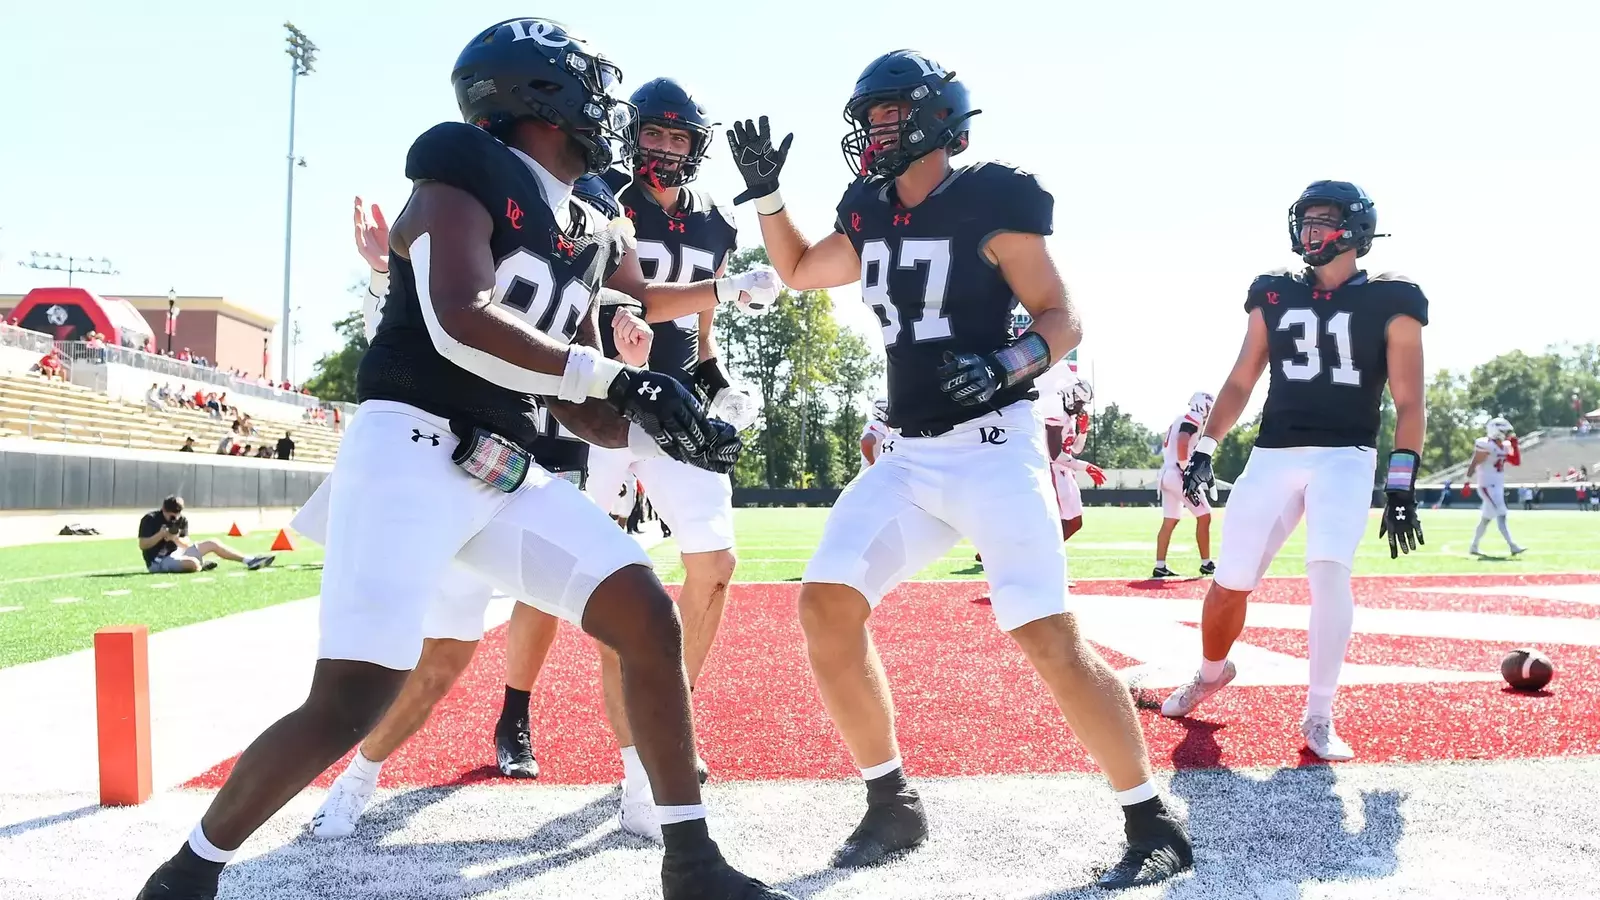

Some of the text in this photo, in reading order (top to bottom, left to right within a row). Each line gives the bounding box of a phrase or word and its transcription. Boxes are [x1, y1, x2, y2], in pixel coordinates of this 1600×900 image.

[505, 197, 524, 229] DC
[860, 237, 955, 347] 87
[1276, 307, 1361, 387] 31
[979, 426, 1008, 445] DC
